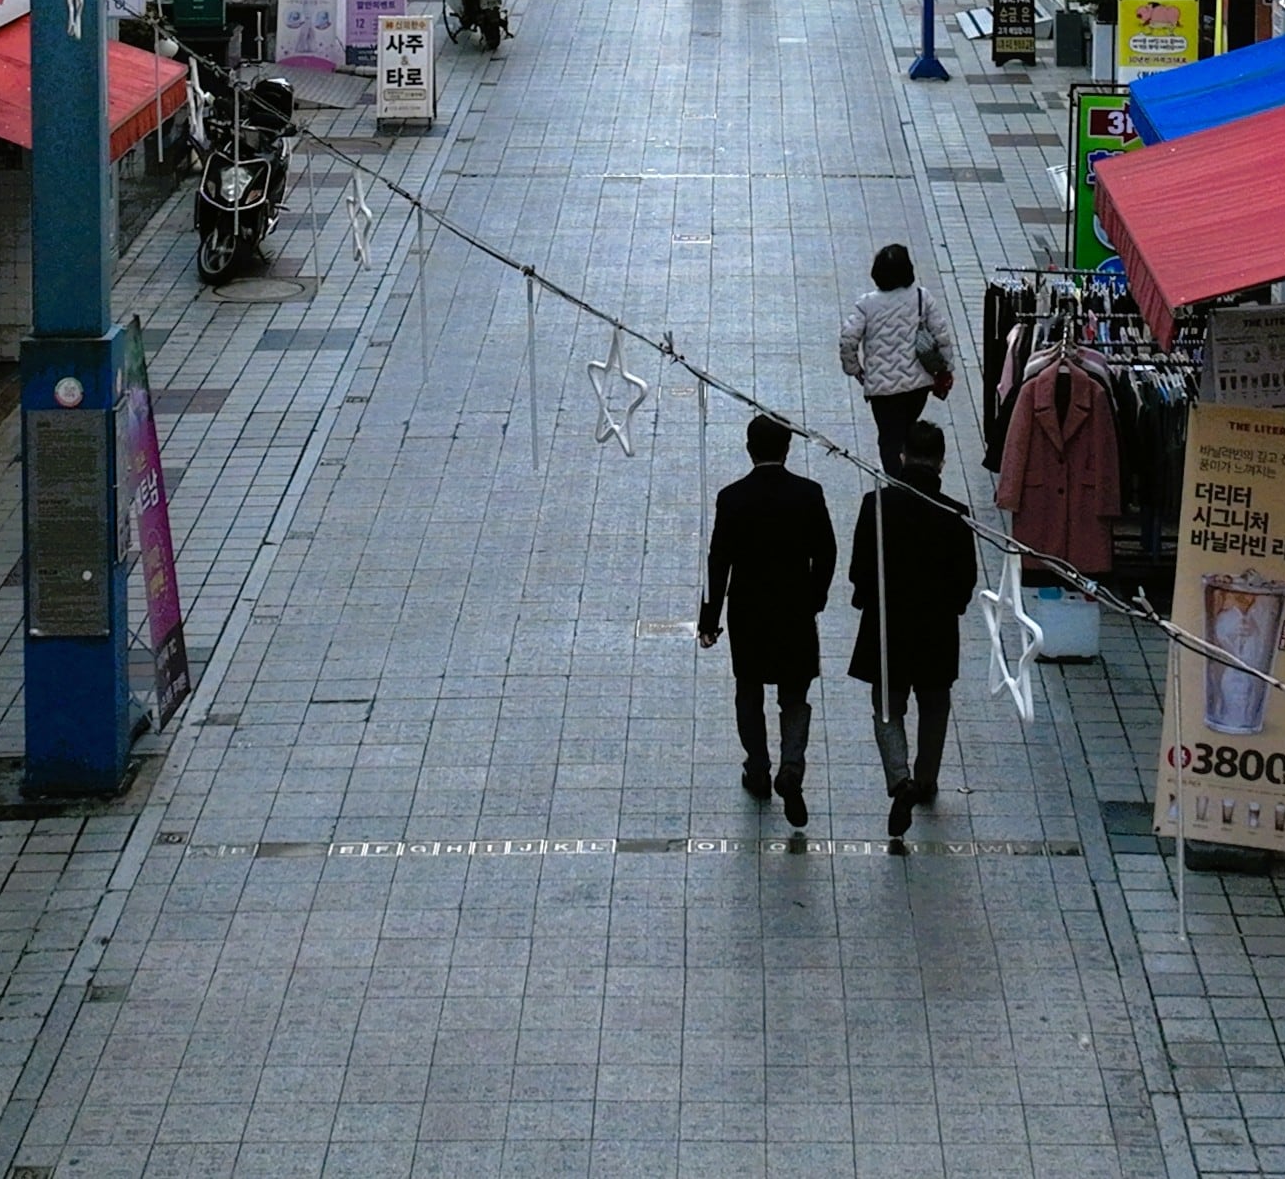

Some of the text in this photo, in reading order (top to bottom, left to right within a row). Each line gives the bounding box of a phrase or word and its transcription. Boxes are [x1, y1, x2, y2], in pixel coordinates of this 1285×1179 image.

[385, 34, 425, 54] 사주
[385, 67, 424, 88] 타로
[1229, 420, 1250, 433] THE
[1195, 482, 1253, 508] 더리터
[1192, 505, 1269, 535] 시그니처
[1190, 529, 1267, 559] 바닐라빈
